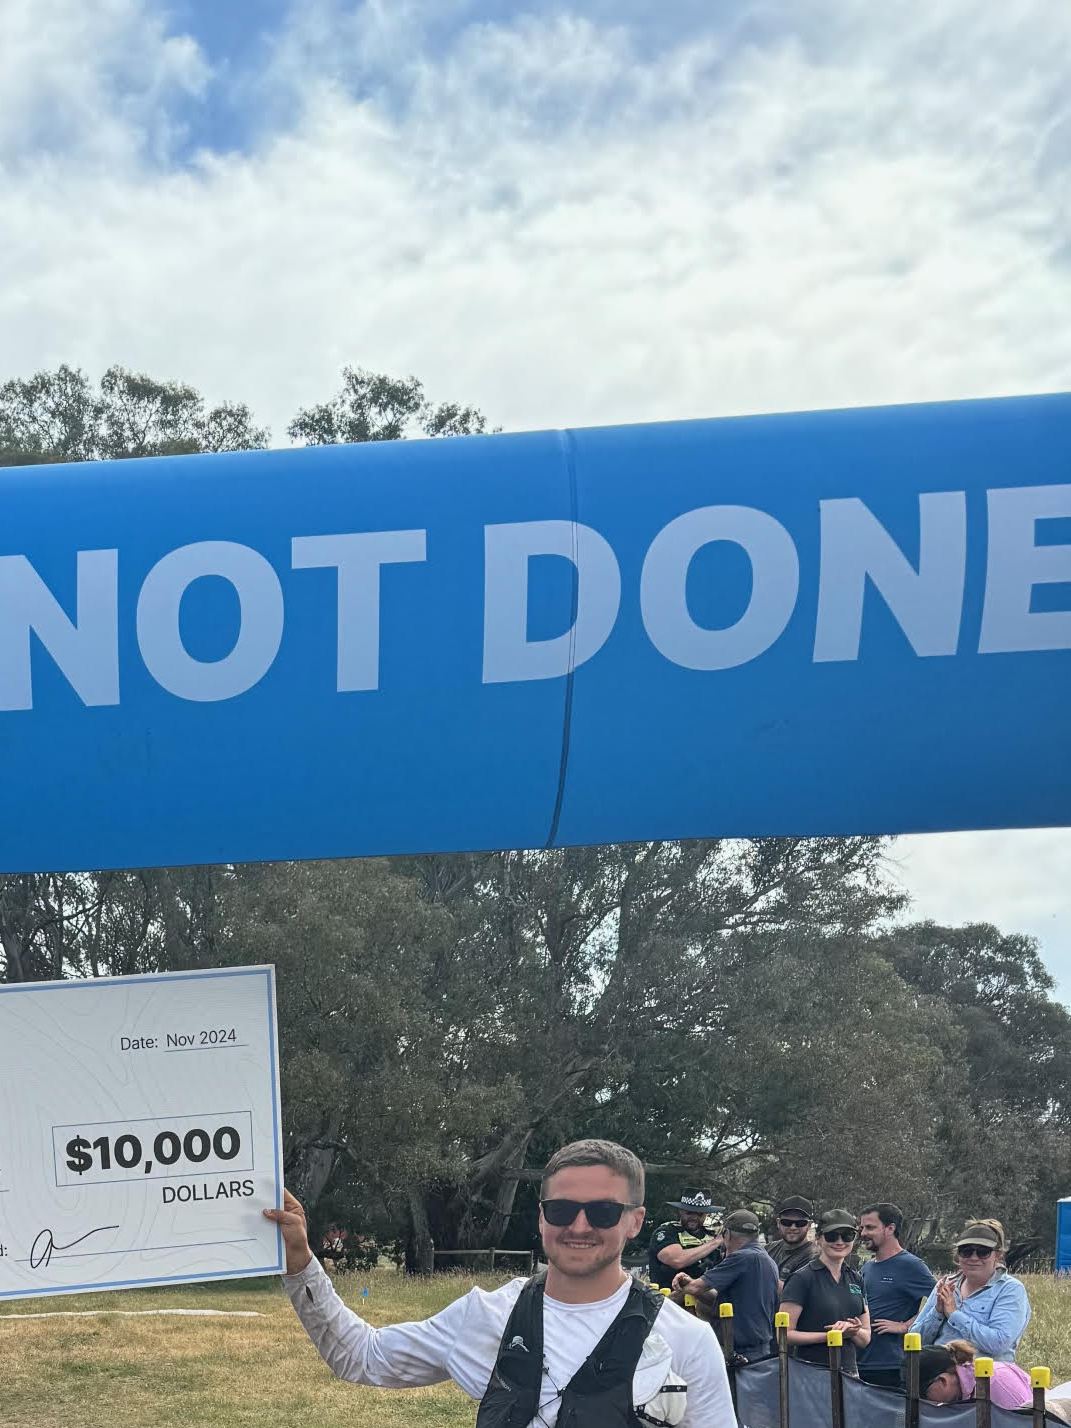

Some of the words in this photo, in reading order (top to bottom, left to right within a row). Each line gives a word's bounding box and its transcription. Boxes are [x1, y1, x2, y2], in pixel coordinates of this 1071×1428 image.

[480, 484, 1071, 685] DONE
[120, 1037, 158, 1051] Date:
[166, 1033, 195, 1047] Nov
[199, 1028, 236, 1045] 2024
[66, 1126, 241, 1175] $10,000
[162, 1180, 255, 1203] DOLLARS
